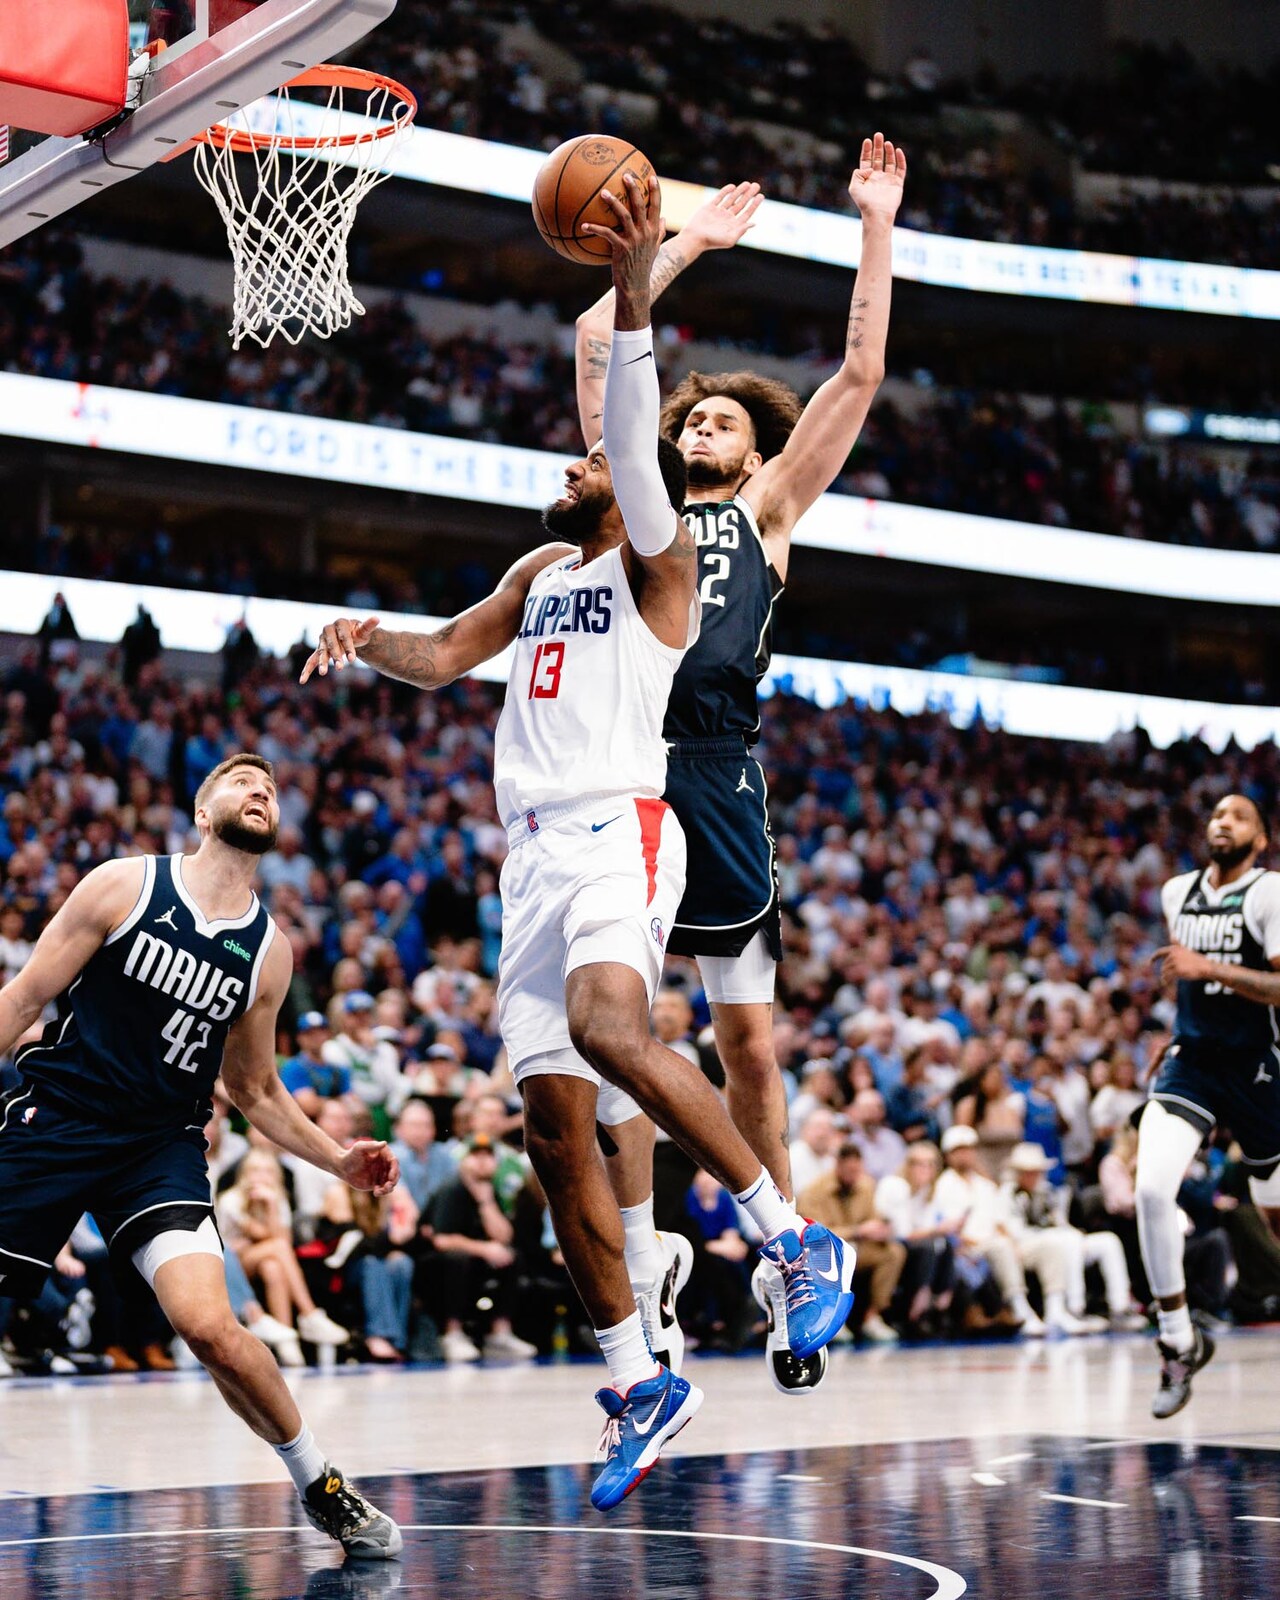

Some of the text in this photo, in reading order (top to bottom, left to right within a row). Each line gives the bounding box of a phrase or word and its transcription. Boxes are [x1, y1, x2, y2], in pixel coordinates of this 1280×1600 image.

[226, 418, 340, 466] FORD
[409, 446, 478, 486] THE
[700, 553, 731, 608] 2
[528, 641, 566, 701] 13
[123, 930, 245, 1022] MAVS
[223, 939, 251, 962] chime
[160, 1007, 212, 1074] 42
